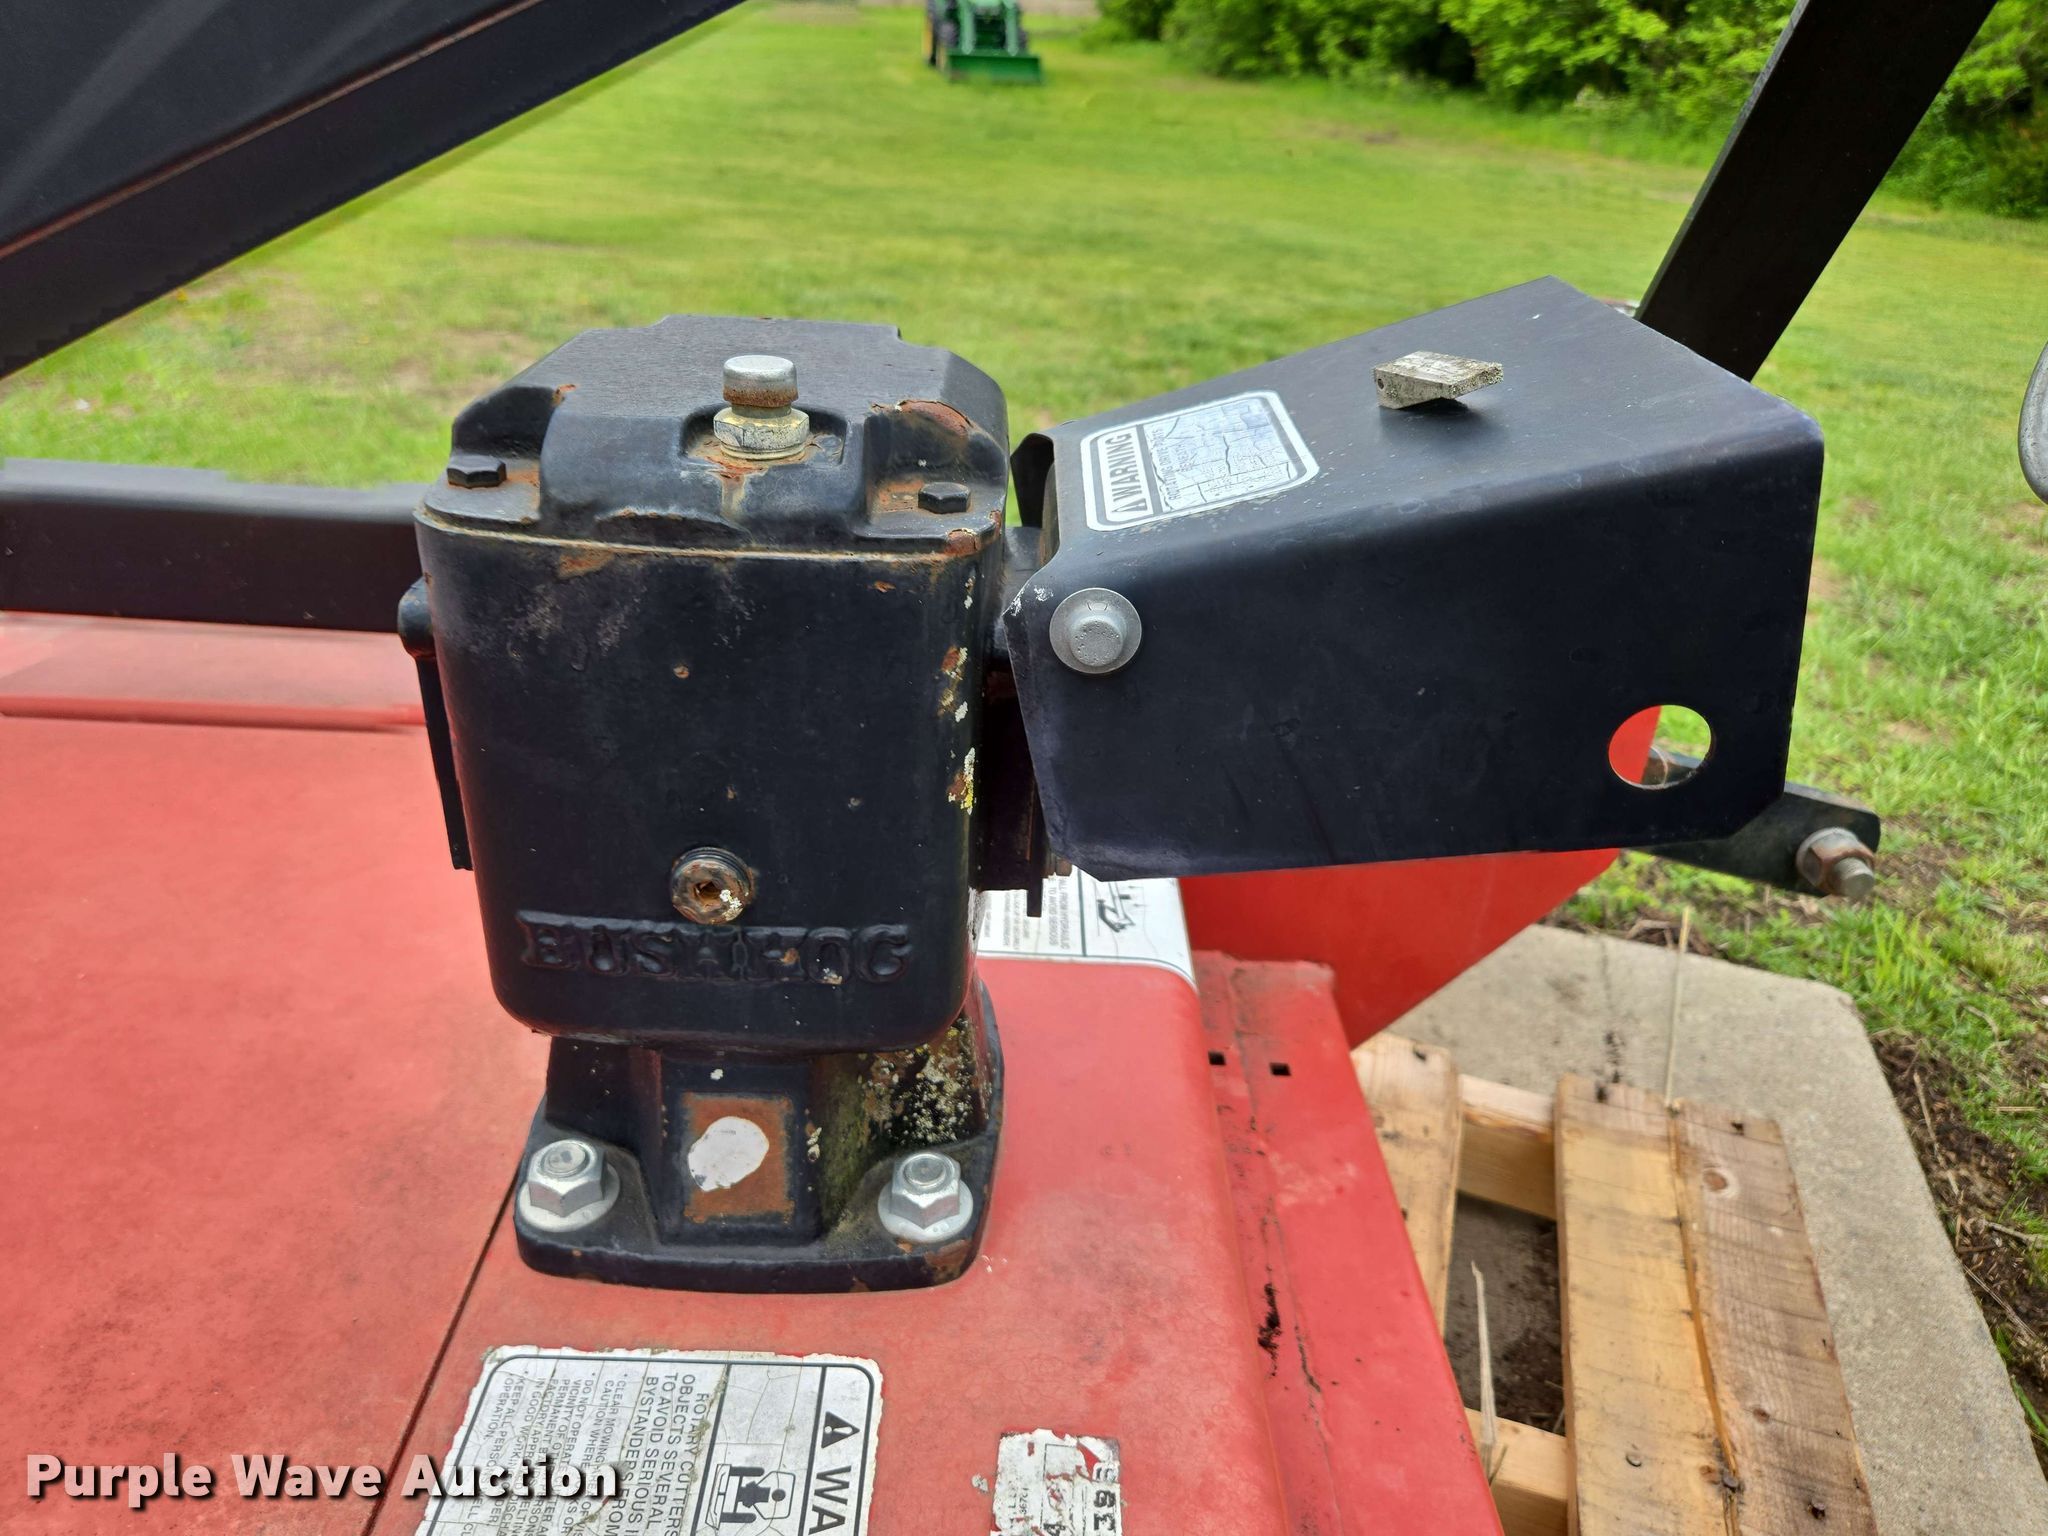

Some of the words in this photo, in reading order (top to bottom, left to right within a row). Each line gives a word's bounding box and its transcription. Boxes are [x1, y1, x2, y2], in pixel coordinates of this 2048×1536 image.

[1104, 432, 1143, 497] WARNING
[509, 1378, 526, 1403] KEEP
[534, 1378, 559, 1425] FACTORY
[535, 1378, 546, 1388] IN
[559, 1379, 582, 1421] VICINITY
[581, 1379, 594, 1394] DO
[608, 1380, 626, 1414] CLEAR
[661, 1372, 678, 1392] TO
[501, 1409, 516, 1427] ALL
[523, 1391, 541, 1421] GOOD
[540, 1378, 570, 1443] PERMANENT
[575, 1397, 589, 1417] NOT
[592, 1380, 614, 1425] CAUTION
[648, 1396, 672, 1443] AVOID
[666, 1374, 696, 1445] OBJECTS
[554, 1424, 567, 1438] OF
[595, 1418, 616, 1462] MOWING
[683, 1393, 709, 1453] ROTARY
[580, 1429, 600, 1467] WHERE
[627, 1448, 659, 1523] SERIOUS
[645, 1450, 677, 1529] SEVERAL
[578, 1501, 591, 1516] OF
